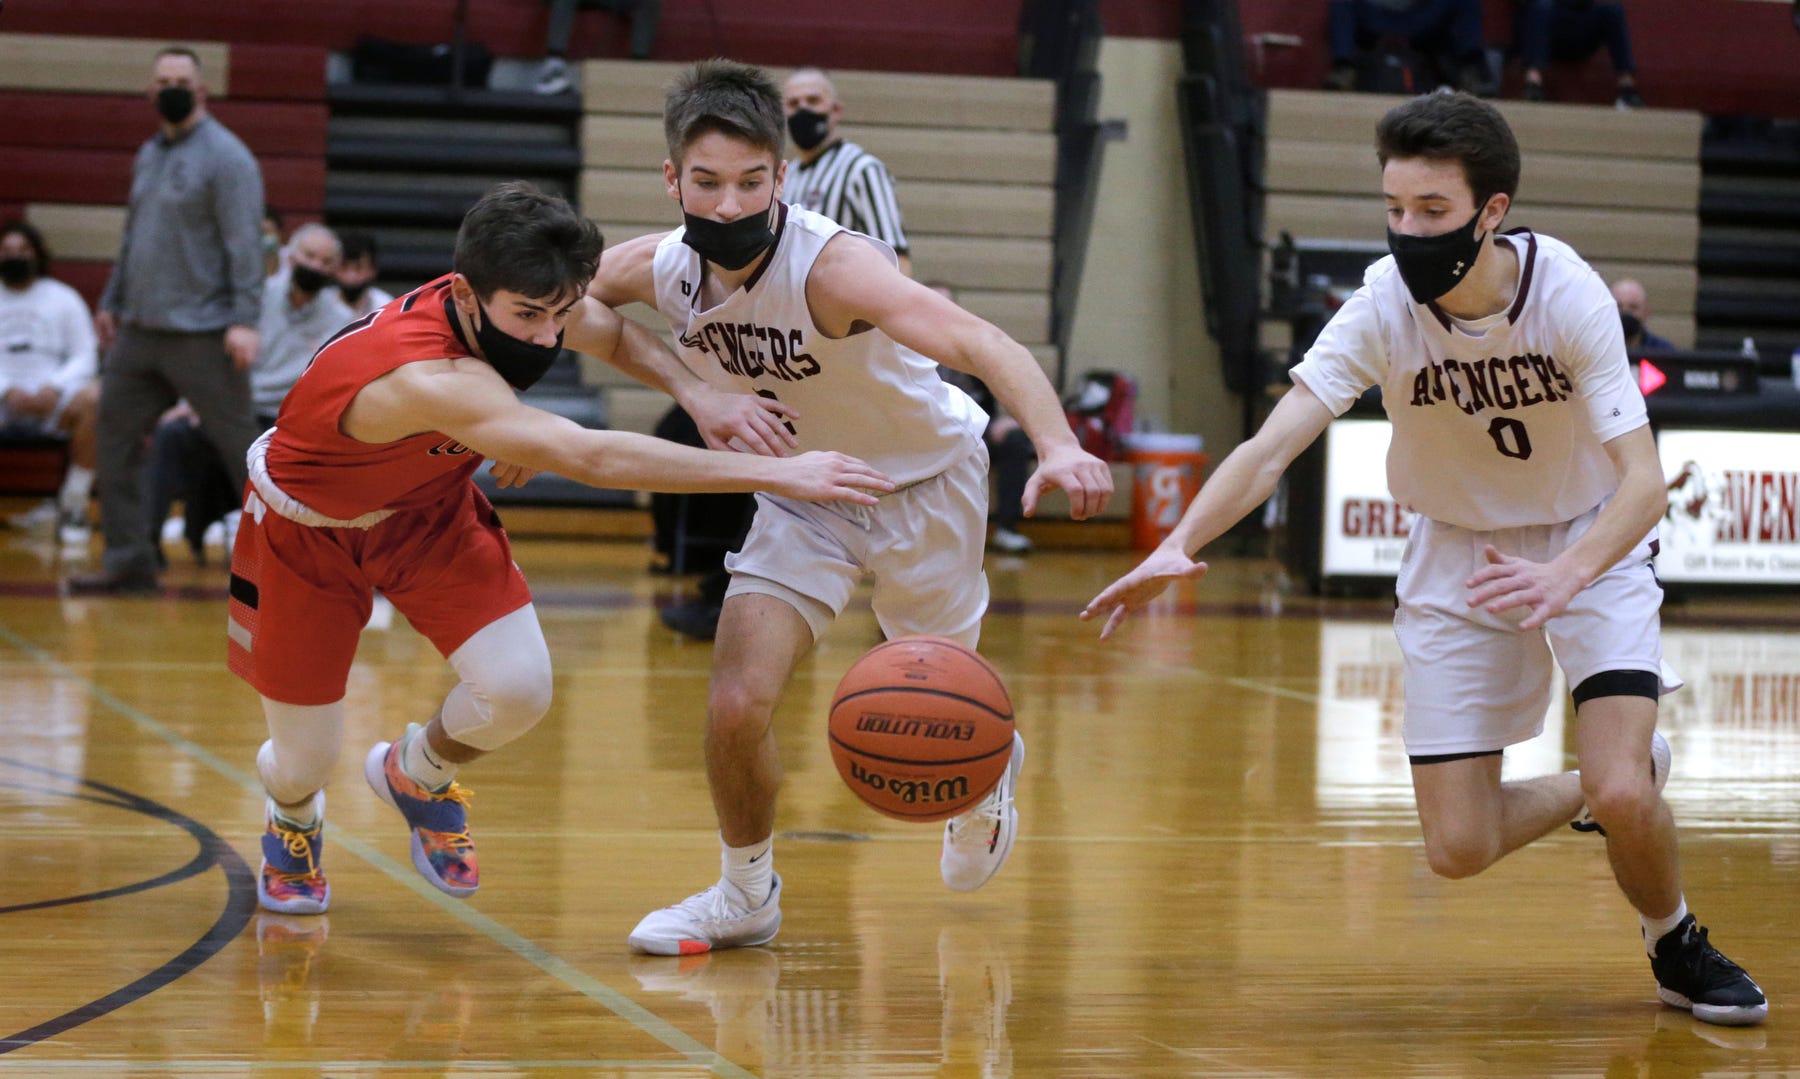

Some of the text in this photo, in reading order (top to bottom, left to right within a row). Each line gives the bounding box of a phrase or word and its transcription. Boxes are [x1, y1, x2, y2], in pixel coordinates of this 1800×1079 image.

[680, 321, 821, 382] ENGERS
[1487, 416, 1532, 460] 0
[856, 715, 976, 741] EVOLUTION
[850, 759, 970, 804] Wilson
